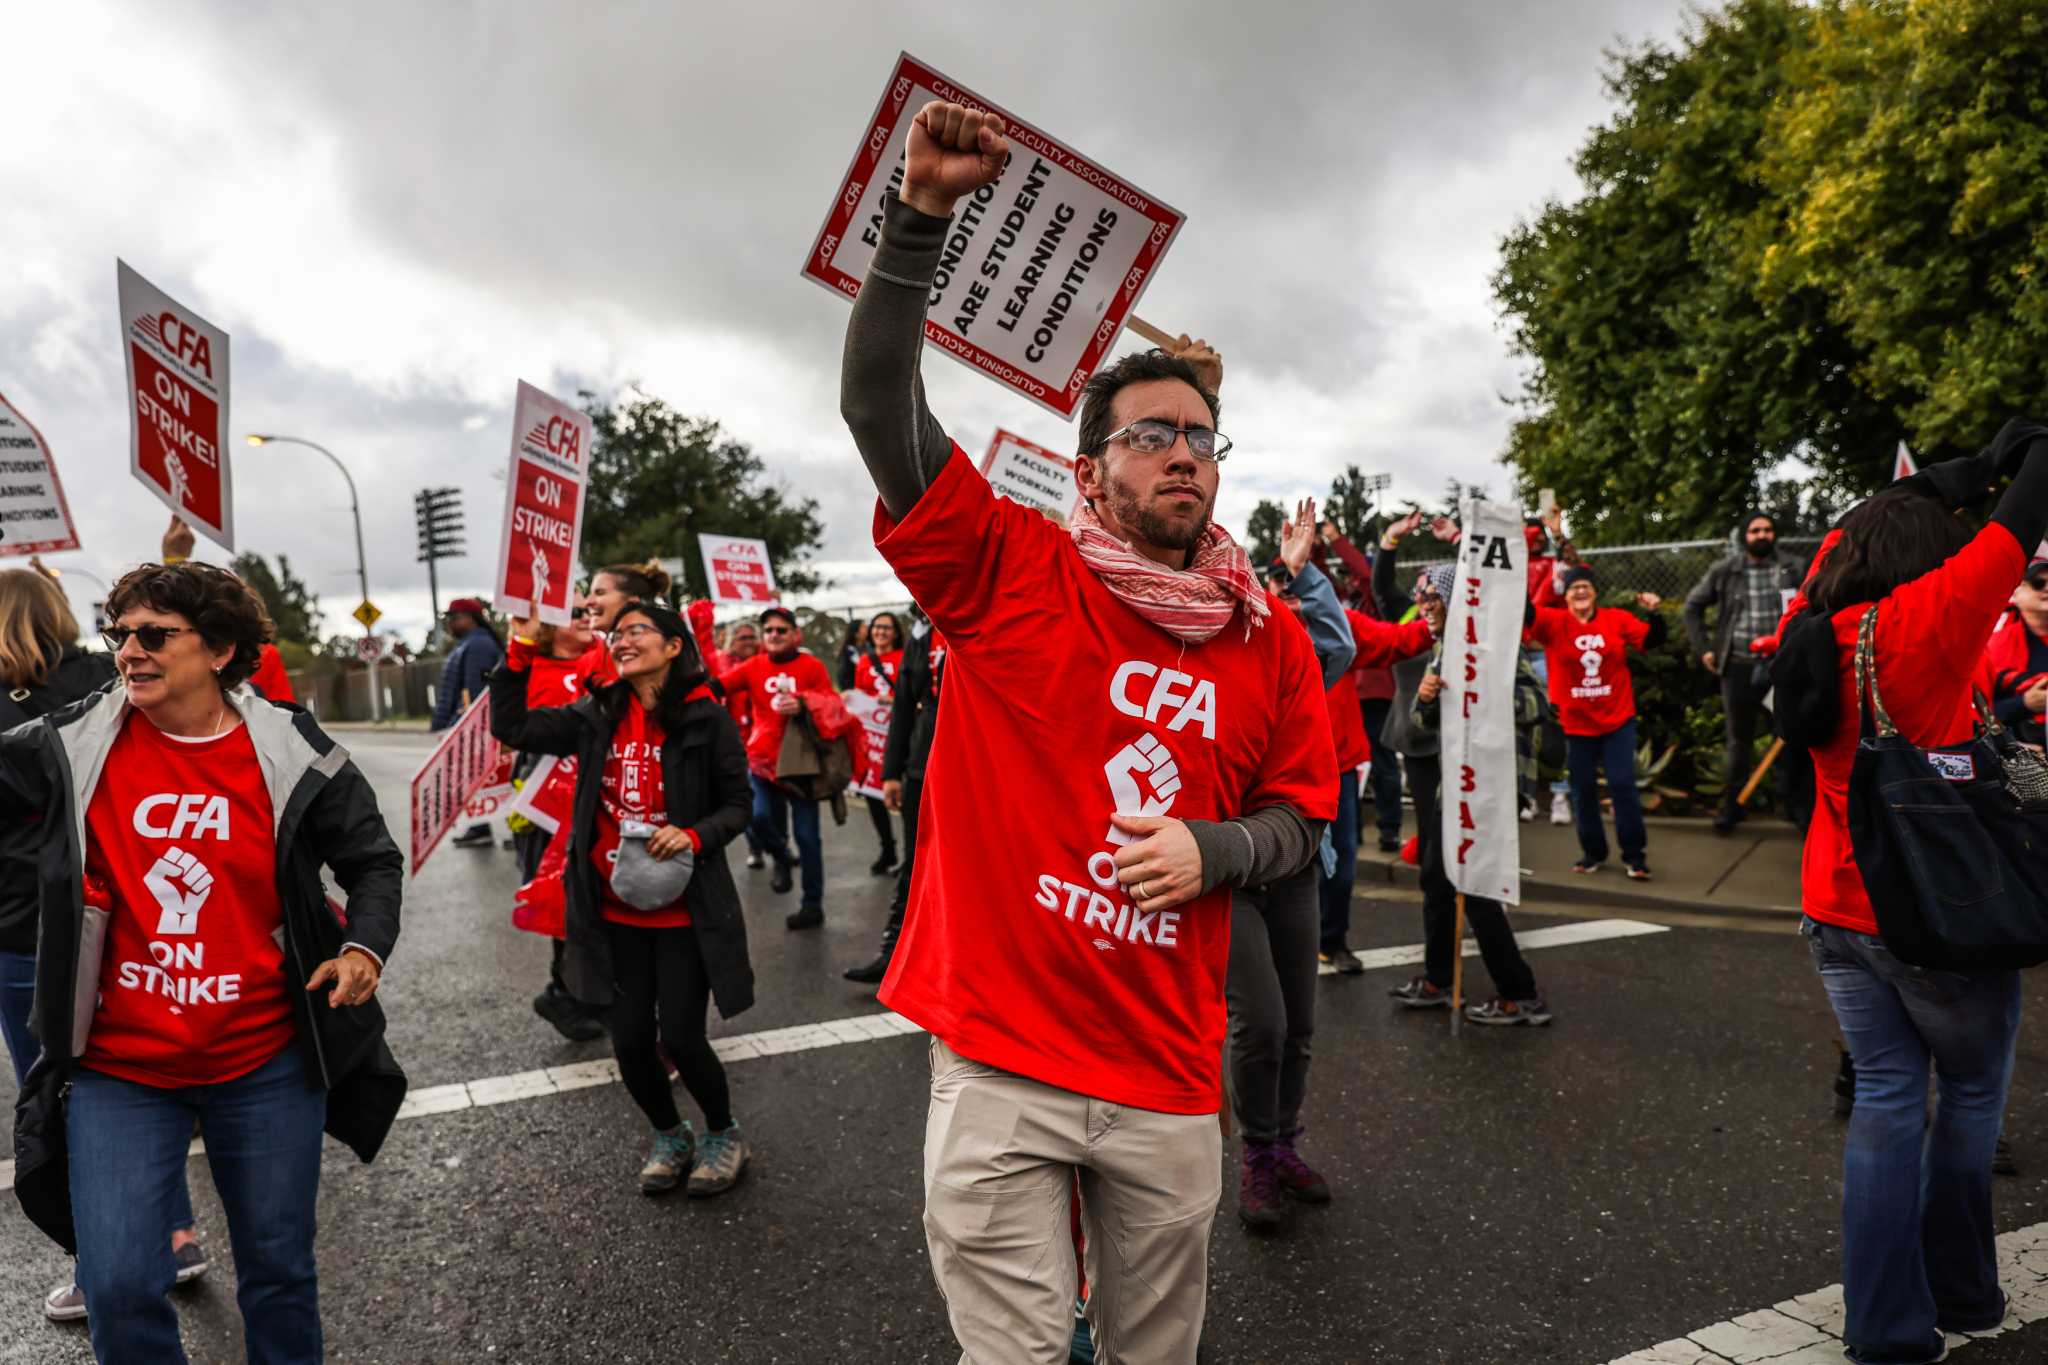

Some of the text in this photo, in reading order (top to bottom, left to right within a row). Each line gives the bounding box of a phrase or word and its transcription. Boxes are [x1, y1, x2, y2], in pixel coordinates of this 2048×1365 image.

[892, 76, 912, 102] CFA
[870, 125, 889, 151] CFA
[932, 81, 1149, 212] CALIFOR FACULTY ASSOCIATION
[844, 181, 863, 206] CFA
[820, 234, 839, 259] CFA
[953, 157, 1051, 337] ARE STUDENT
[1151, 221, 1171, 246] CFA
[996, 202, 1076, 333] LEARNING
[1025, 207, 1118, 364] CONDITIONS
[1125, 266, 1145, 291] CFA
[158, 312, 213, 380] CFA
[1096, 318, 1116, 342] CFA
[154, 370, 191, 418] ON
[976, 352, 1046, 397] CALIFORNIA
[1069, 368, 1089, 393] CFA
[137, 388, 217, 469] STRIKE!
[546, 415, 581, 464] CFA
[1004, 467, 1063, 501] WORKING
[1013, 453, 1068, 483] FACULTY
[535, 475, 562, 509] ON
[514, 506, 573, 548] STRIKE!
[1109, 660, 1216, 740] CFA
[132, 793, 230, 841] CFA
[1087, 851, 1129, 894] O
[1034, 873, 1181, 948] STRIKE
[148, 940, 204, 970] ON
[117, 961, 242, 1006] STRIKE
